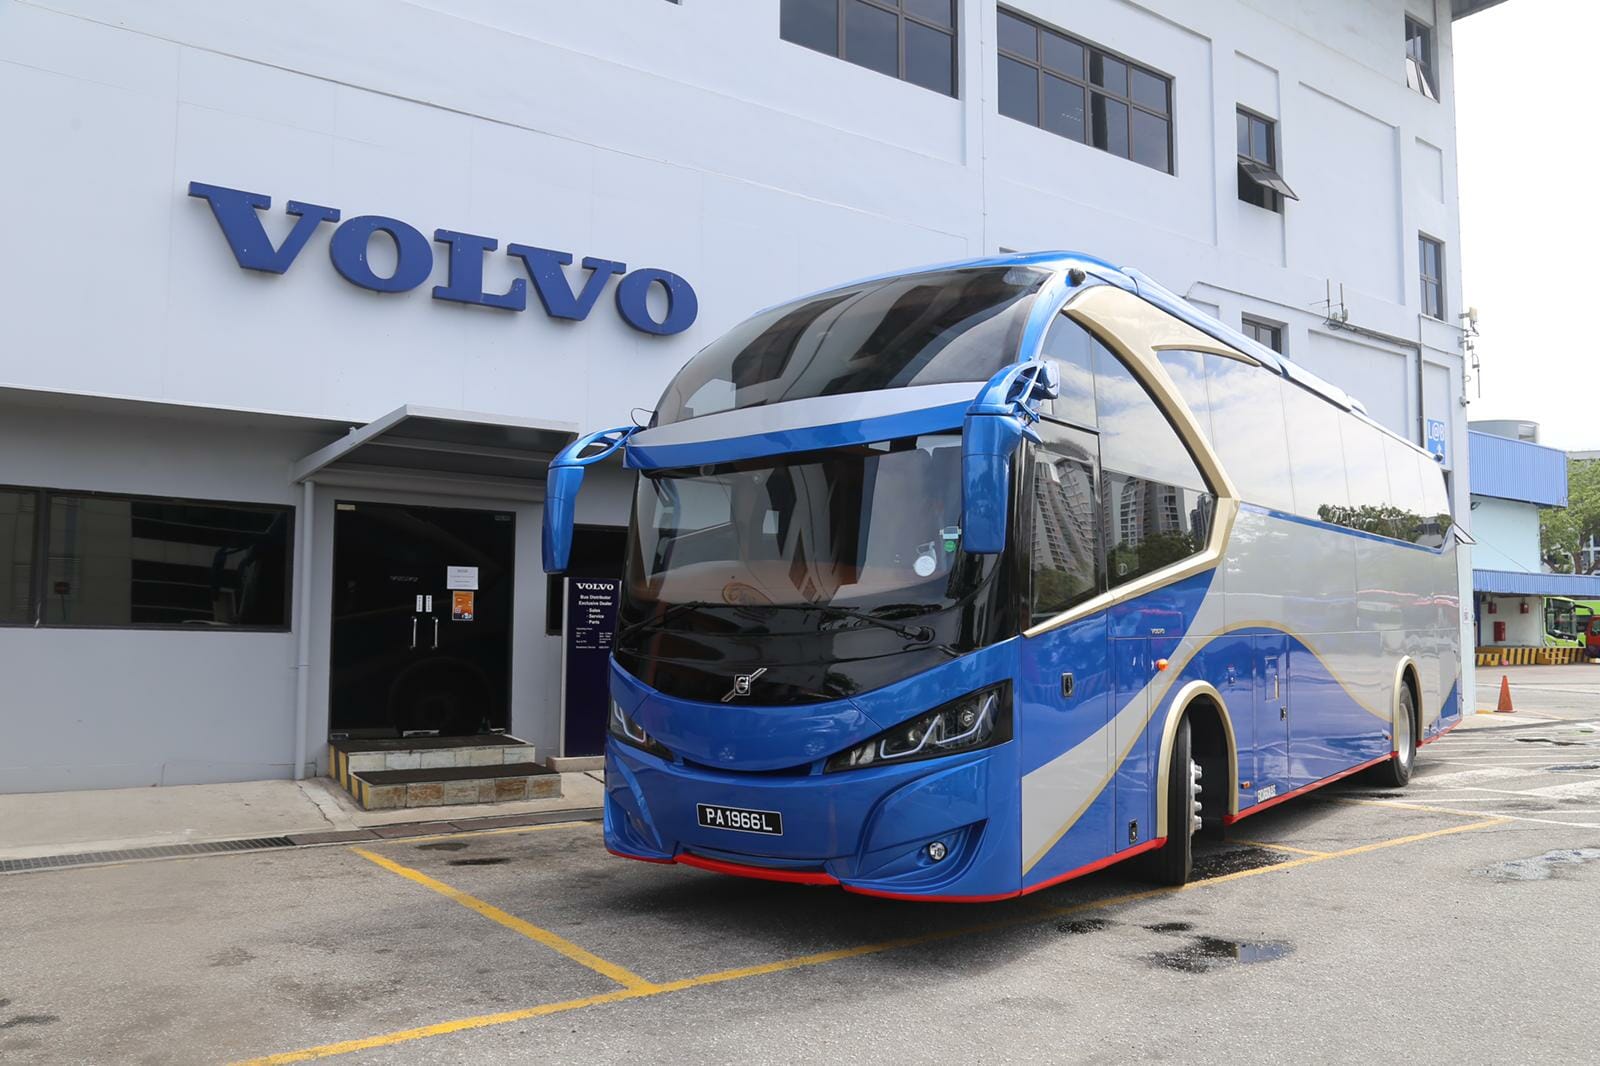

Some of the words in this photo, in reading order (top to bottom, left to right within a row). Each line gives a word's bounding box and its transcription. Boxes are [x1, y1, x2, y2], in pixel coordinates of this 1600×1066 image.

[188, 181, 699, 336] VOLVO
[576, 582, 614, 591] VOLVO
[705, 808, 773, 831] PA1966L
